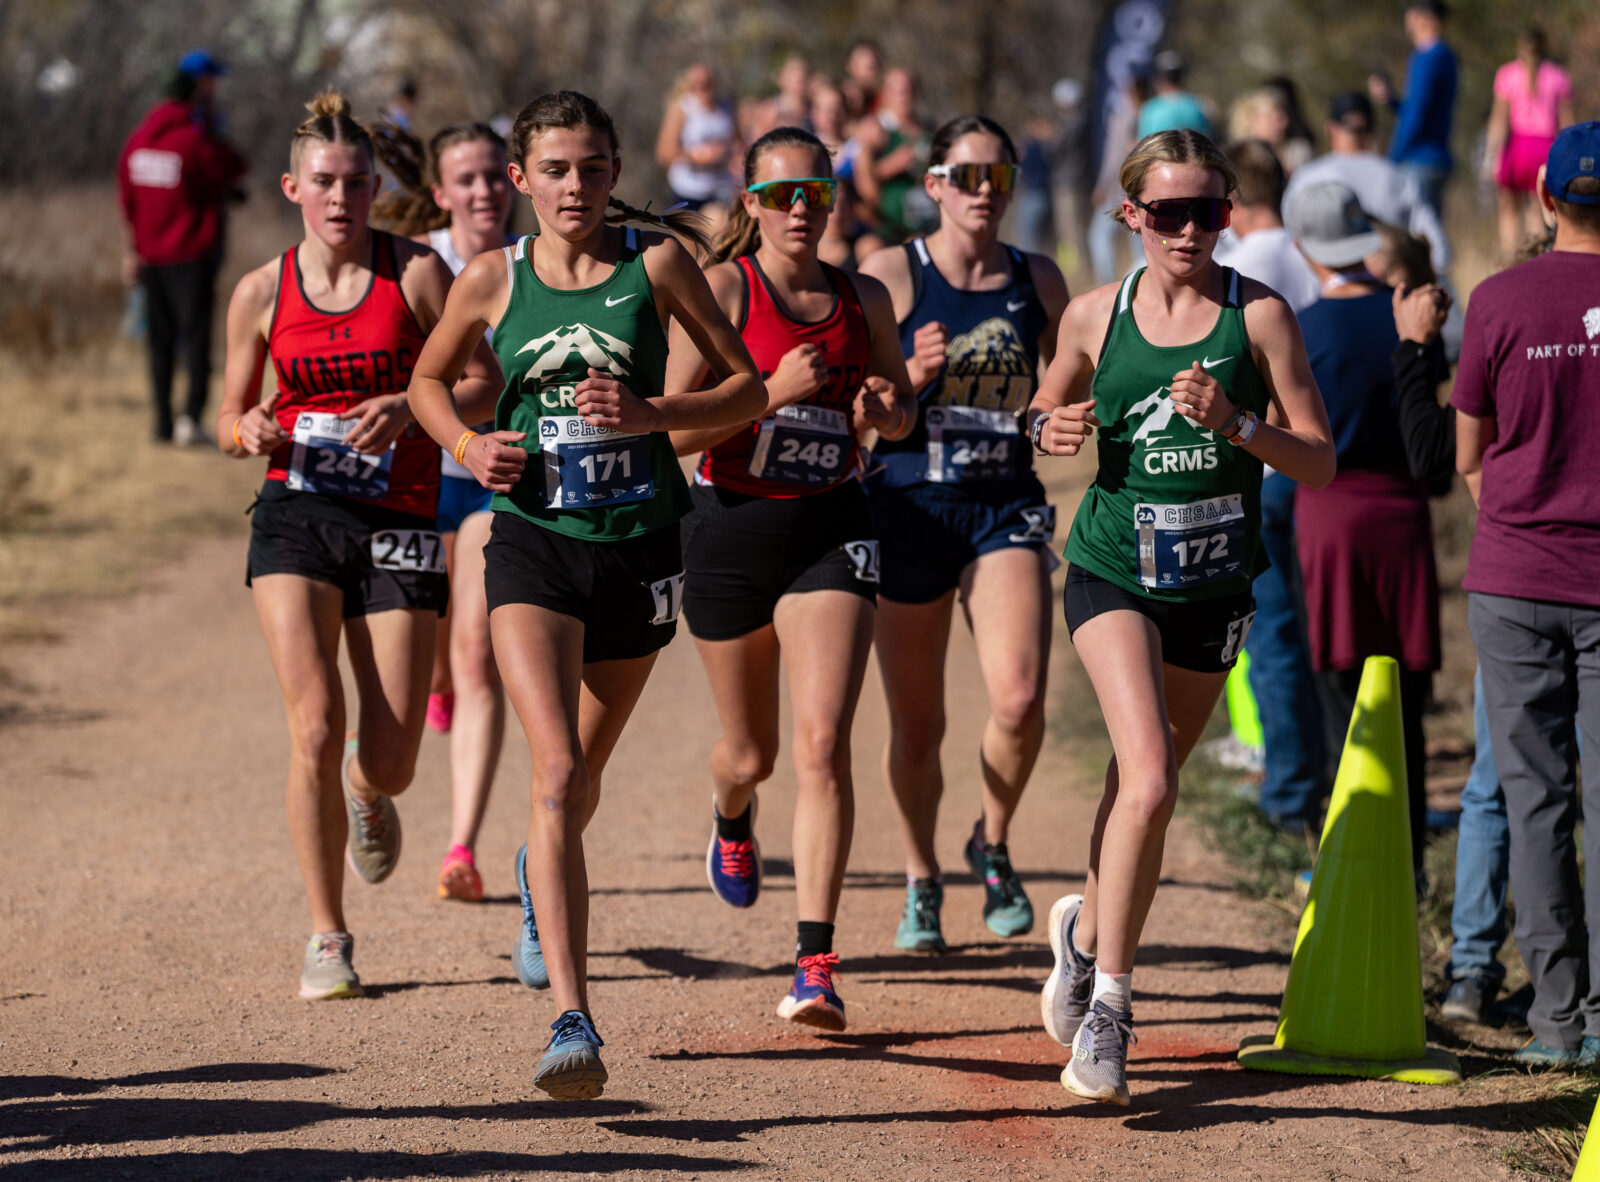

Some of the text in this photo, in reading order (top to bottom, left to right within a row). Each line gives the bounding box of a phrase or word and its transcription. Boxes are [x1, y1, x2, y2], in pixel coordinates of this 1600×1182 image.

[1526, 343, 1563, 361] PART
[1567, 343, 1586, 357] OF
[276, 347, 412, 397] MINERS
[540, 386, 577, 409] CR
[940, 375, 1032, 410] NED
[542, 426, 558, 436] 2A
[315, 448, 380, 481] 247
[777, 438, 841, 469] 248
[950, 439, 1009, 464] 244
[1144, 446, 1218, 475] CRMS
[578, 450, 632, 484] 171
[1138, 511, 1154, 521] 2A
[1164, 498, 1233, 524] CHSAA
[376, 532, 441, 569] 247
[1171, 533, 1229, 568] 172
